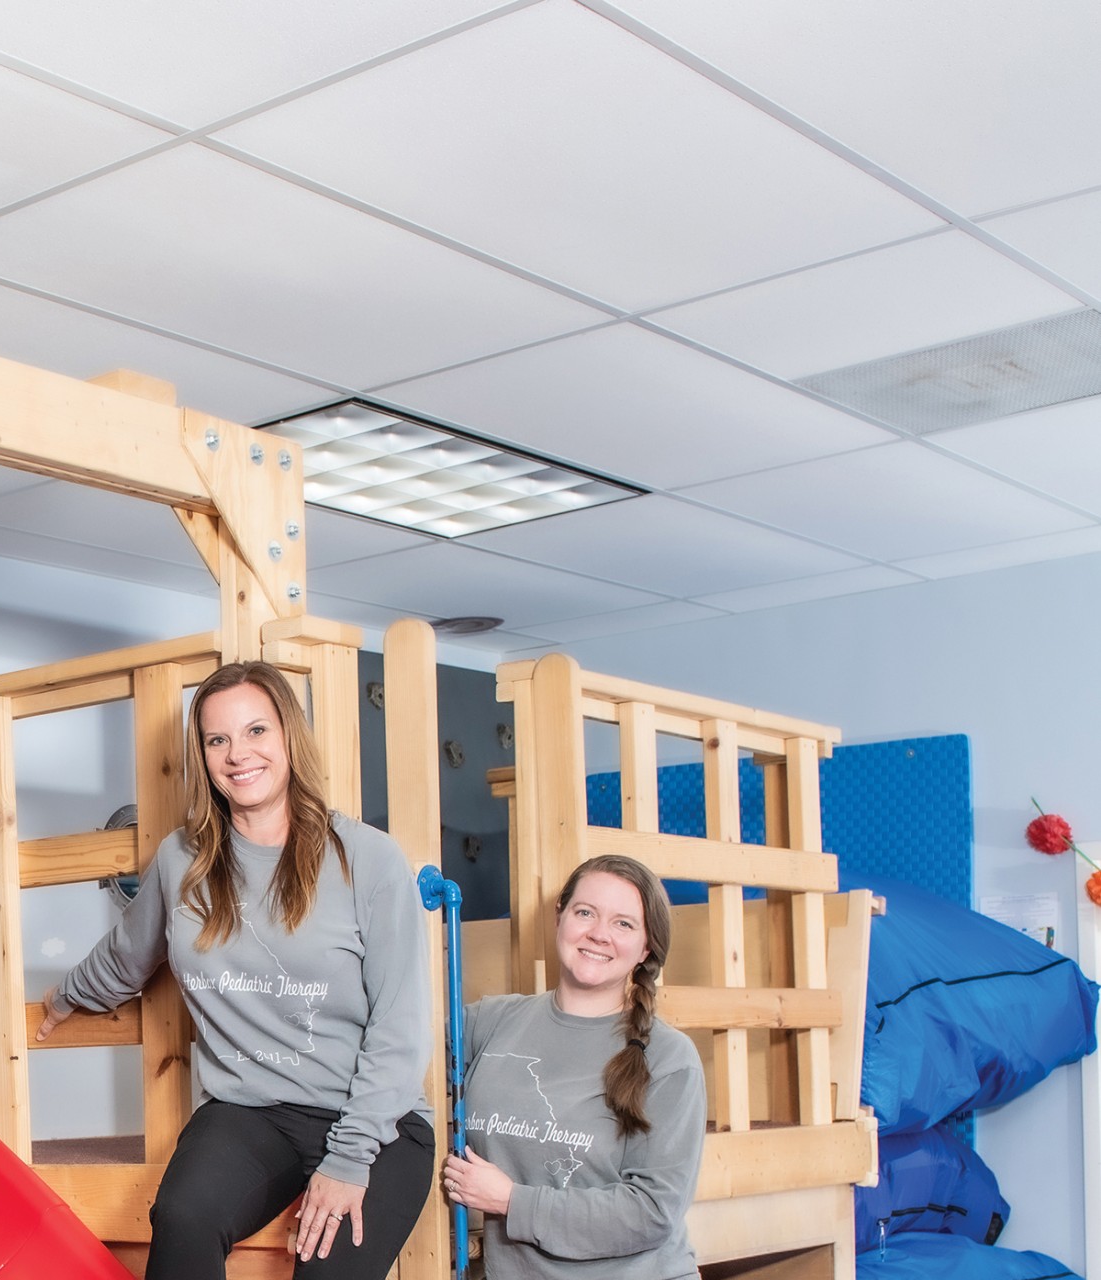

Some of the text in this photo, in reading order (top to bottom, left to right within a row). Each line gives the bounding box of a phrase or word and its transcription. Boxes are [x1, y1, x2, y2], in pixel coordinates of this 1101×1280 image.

[219, 970, 272, 995] Pediatric
[275, 975, 329, 1001] Therapy
[487, 1113, 539, 1139] Pediatric
[540, 1121, 594, 1152] Therapy
